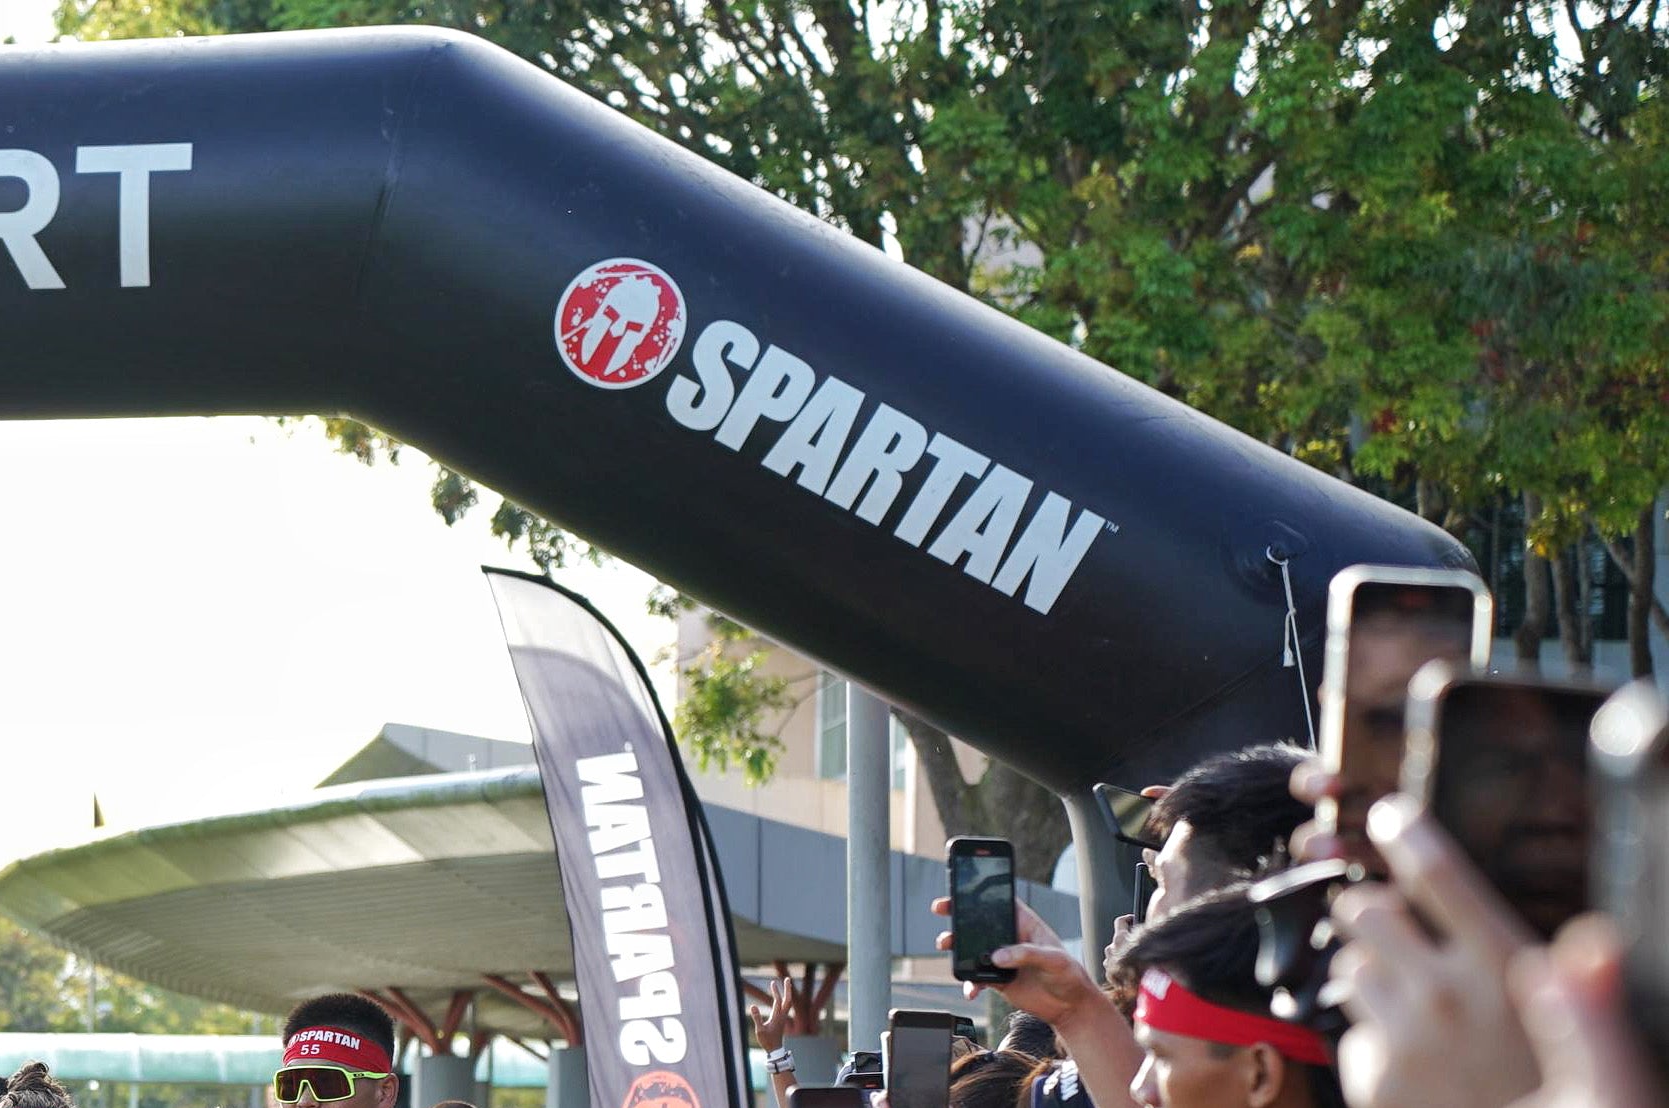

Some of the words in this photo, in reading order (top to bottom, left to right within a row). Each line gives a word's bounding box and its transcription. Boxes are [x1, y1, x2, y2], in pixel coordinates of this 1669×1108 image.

[665, 320, 1107, 616] SPARTAN
[300, 1030, 361, 1050] SPARTAN
[300, 1044, 320, 1055] 55
